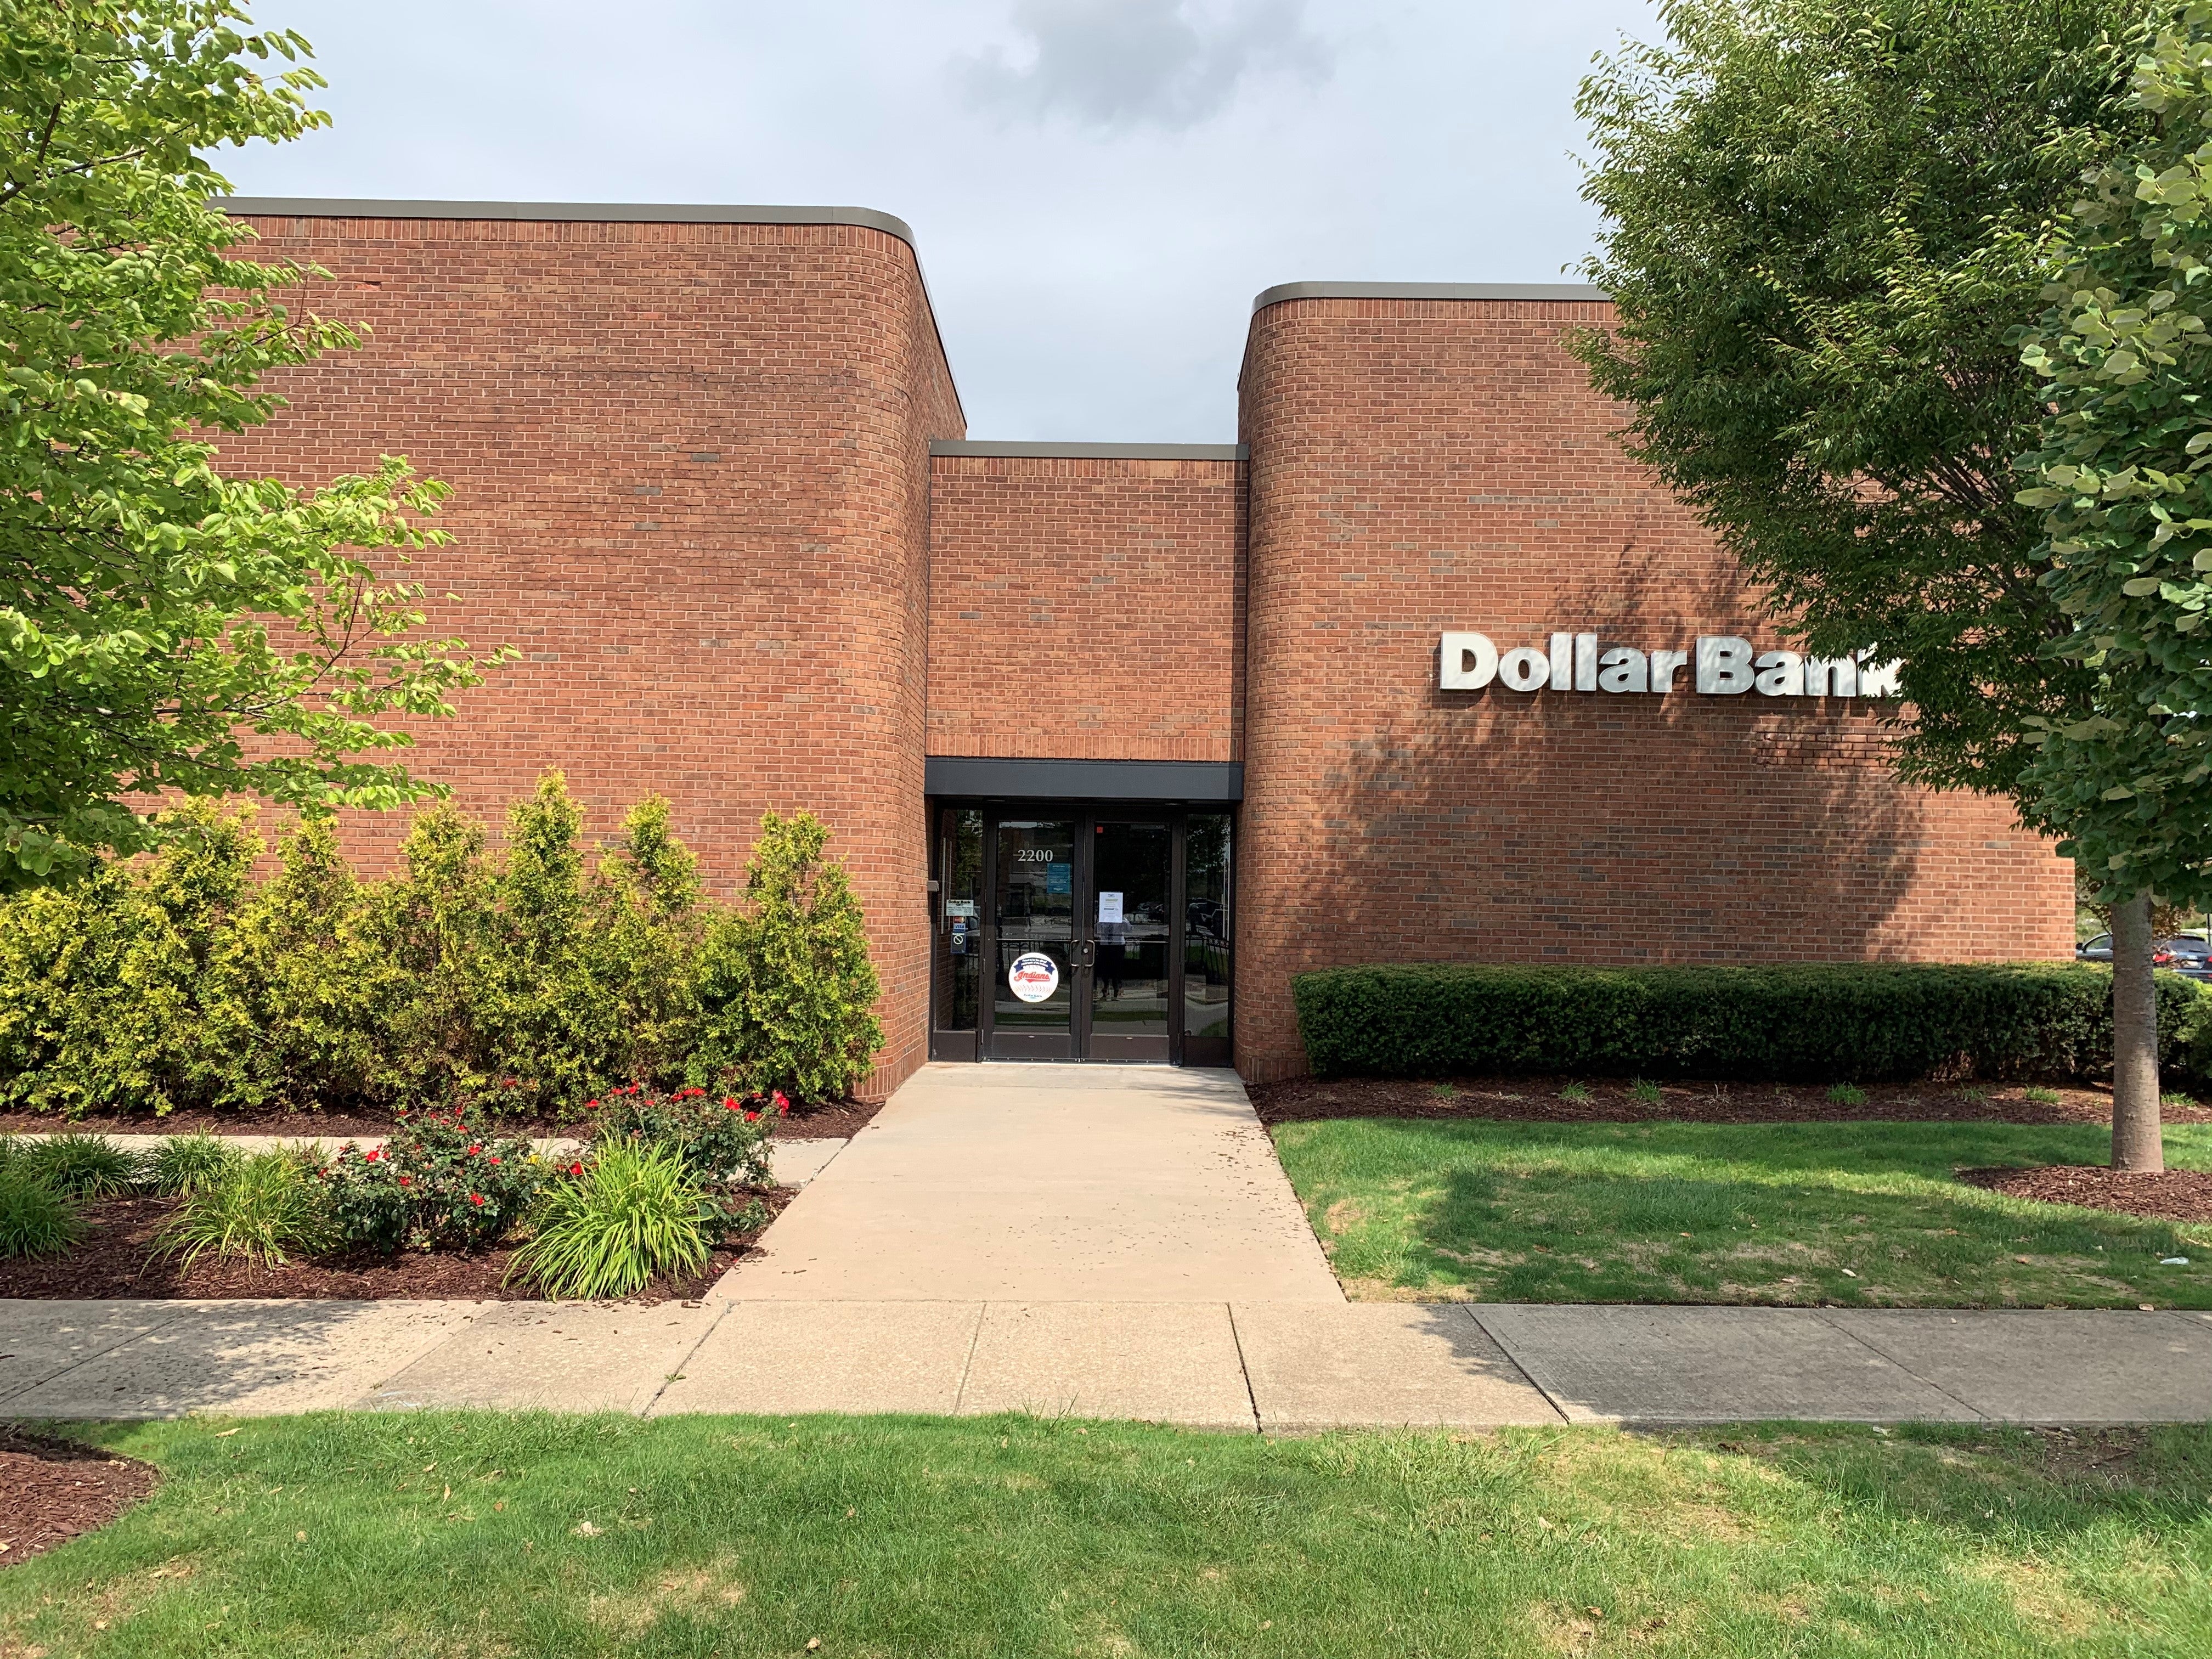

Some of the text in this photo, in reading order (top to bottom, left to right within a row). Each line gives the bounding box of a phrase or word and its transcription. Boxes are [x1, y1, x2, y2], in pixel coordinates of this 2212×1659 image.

[1440, 631, 1687, 693] Dollar
[1018, 849, 1053, 862] 2200
[1014, 971, 1050, 983] Indians
